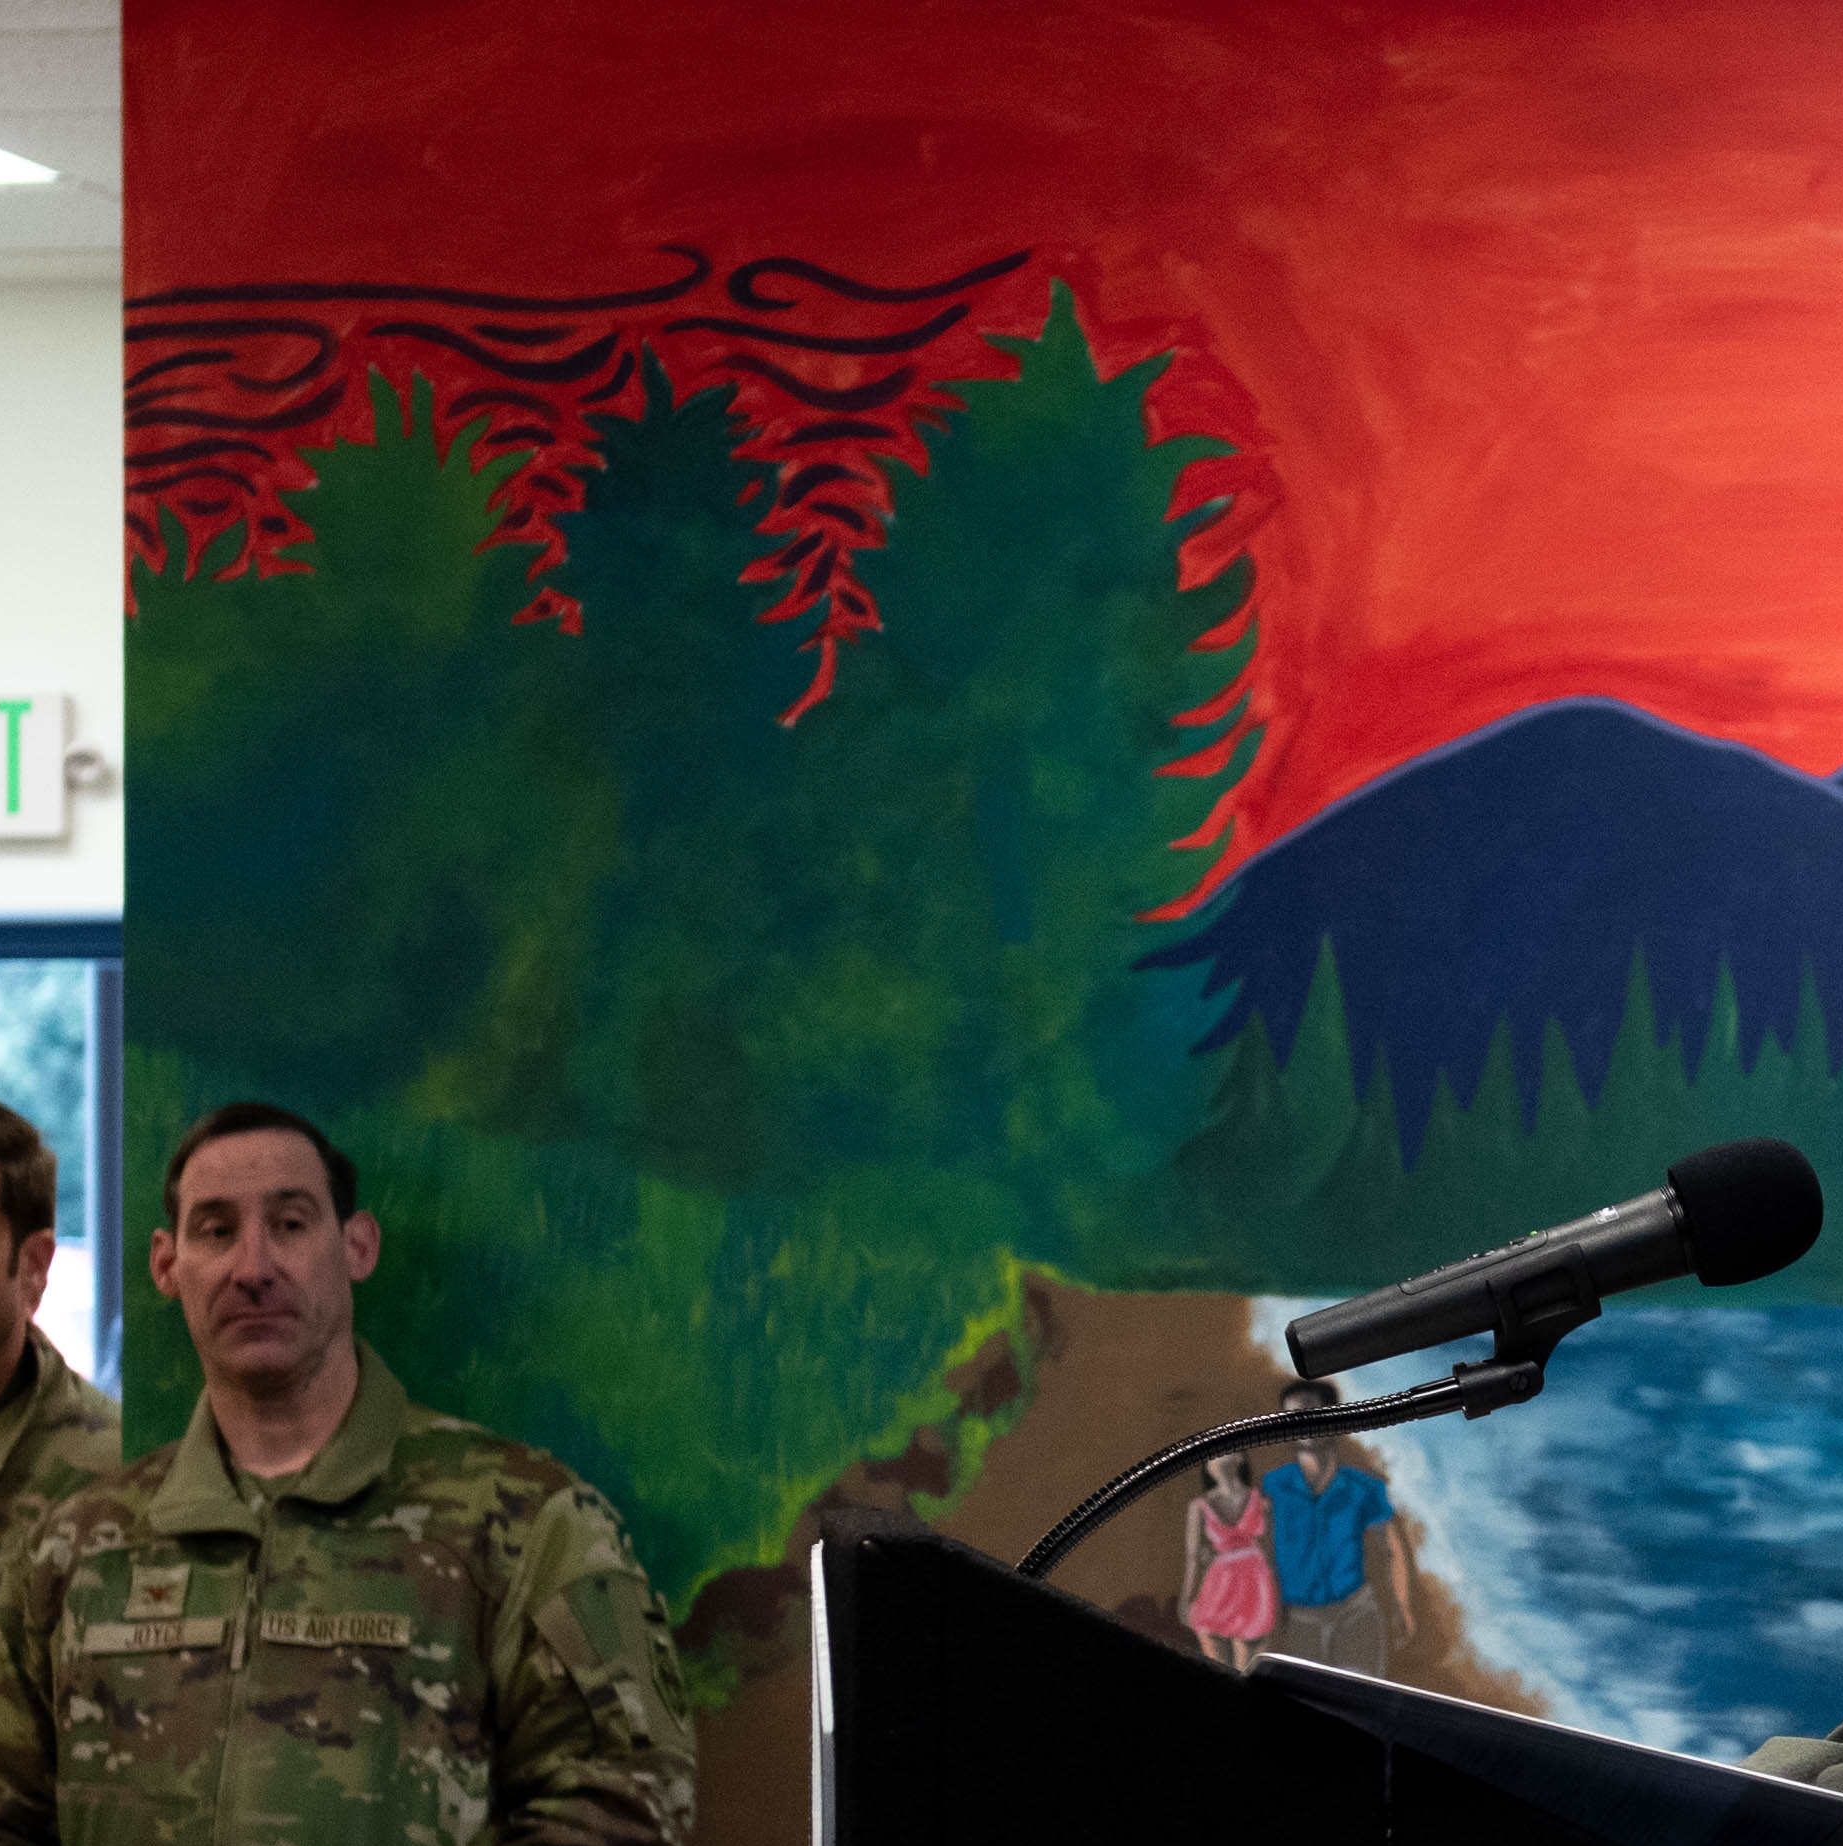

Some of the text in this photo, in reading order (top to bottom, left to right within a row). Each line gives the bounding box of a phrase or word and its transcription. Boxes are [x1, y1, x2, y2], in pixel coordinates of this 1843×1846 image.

[268, 1614, 399, 1641] US AIR FORCE
